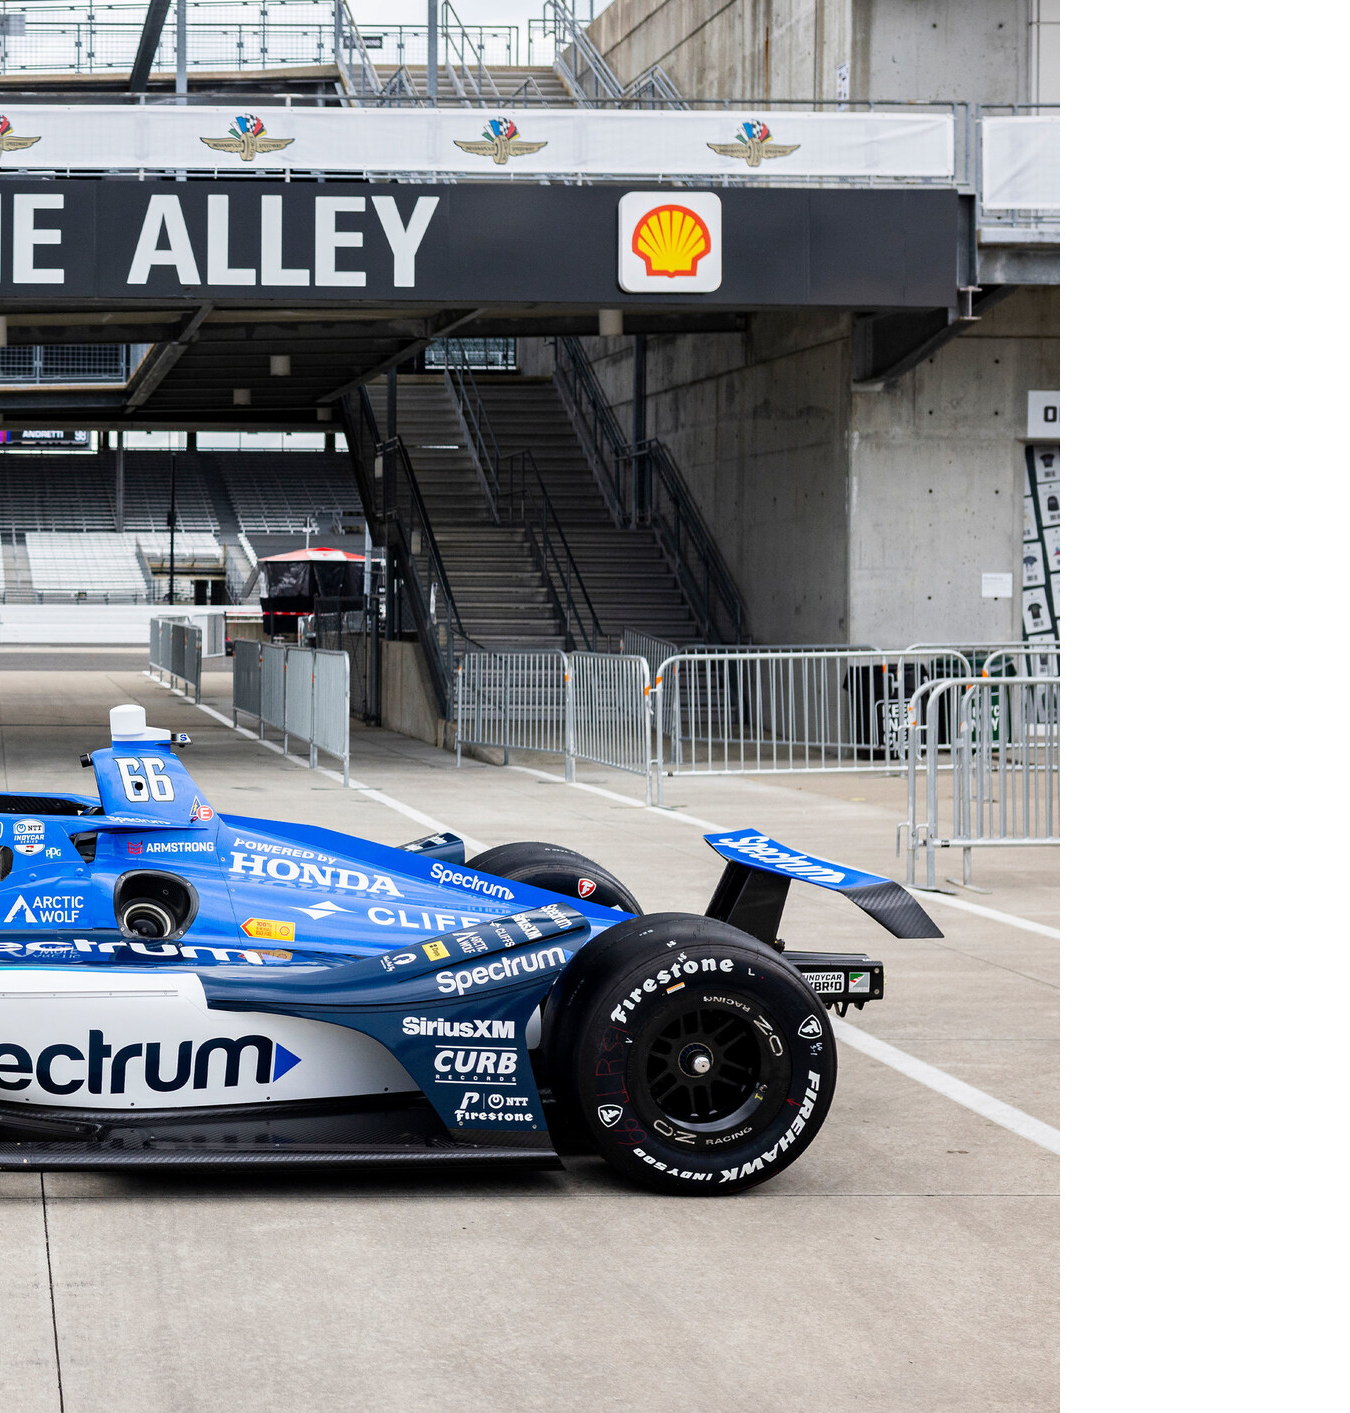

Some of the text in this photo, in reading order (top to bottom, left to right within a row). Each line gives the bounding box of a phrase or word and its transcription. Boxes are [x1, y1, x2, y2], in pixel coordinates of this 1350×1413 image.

[126, 193, 440, 287] ALLEY
[112, 757, 175, 803] 66
[146, 841, 215, 853] ARMSTRONG
[233, 837, 337, 864] POWERED by
[712, 836, 842, 883] Spectrum
[228, 851, 405, 897] HONDA
[430, 862, 510, 900] Spectrum
[32, 895, 84, 909] ARCTIC
[39, 909, 80, 923] WOLF
[367, 906, 481, 932] CLIFF
[435, 947, 567, 996] Spectrum
[610, 957, 734, 1024] Firestone
[401, 1016, 515, 1038] SiriusXM
[434, 1050, 518, 1075] CURB
[435, 1074, 517, 1082] RECORDS
[505, 1097, 529, 1107] NTT
[454, 1109, 534, 1122] Firestone
[718, 1069, 821, 1184] FIREHAWK
[705, 1126, 753, 1145] RACING
